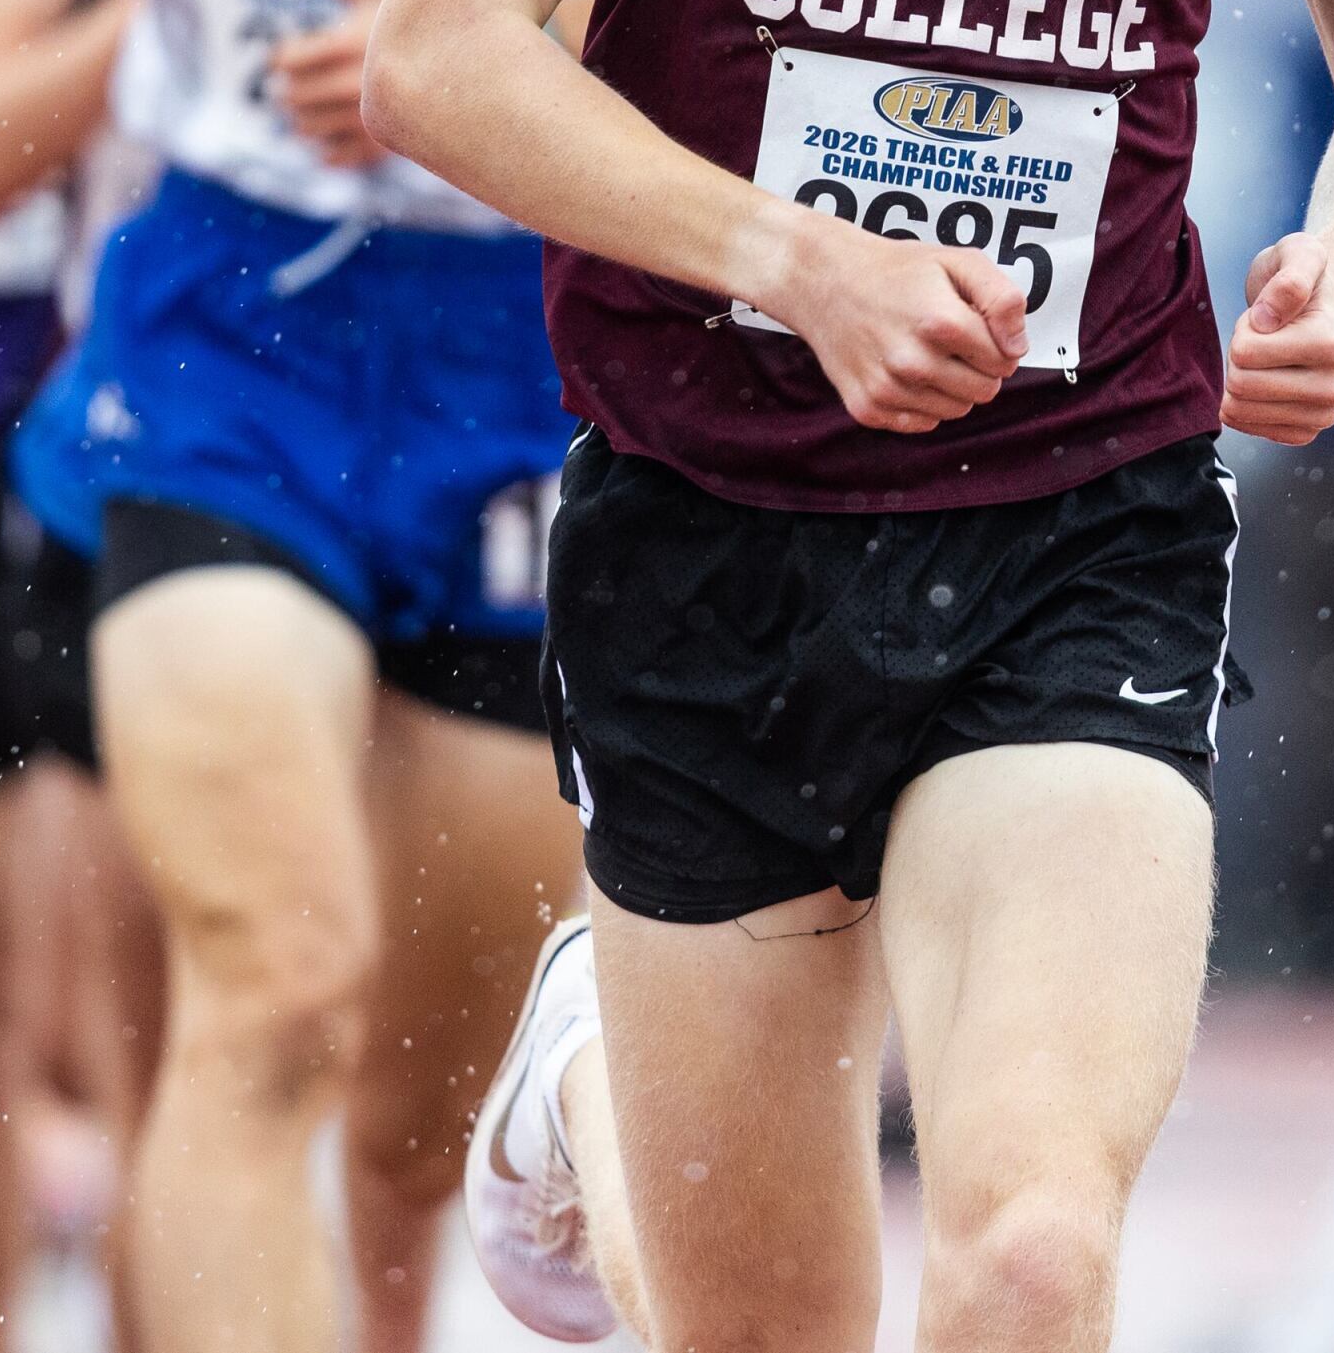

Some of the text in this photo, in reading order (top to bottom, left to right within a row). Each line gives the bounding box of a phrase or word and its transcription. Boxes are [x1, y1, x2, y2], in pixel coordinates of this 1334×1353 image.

[894, 82, 1011, 137] PIAA
[803, 125, 1073, 182] 2026 TRACK & FIELD
[822, 153, 1048, 204] CHAMPIONSHIPS
